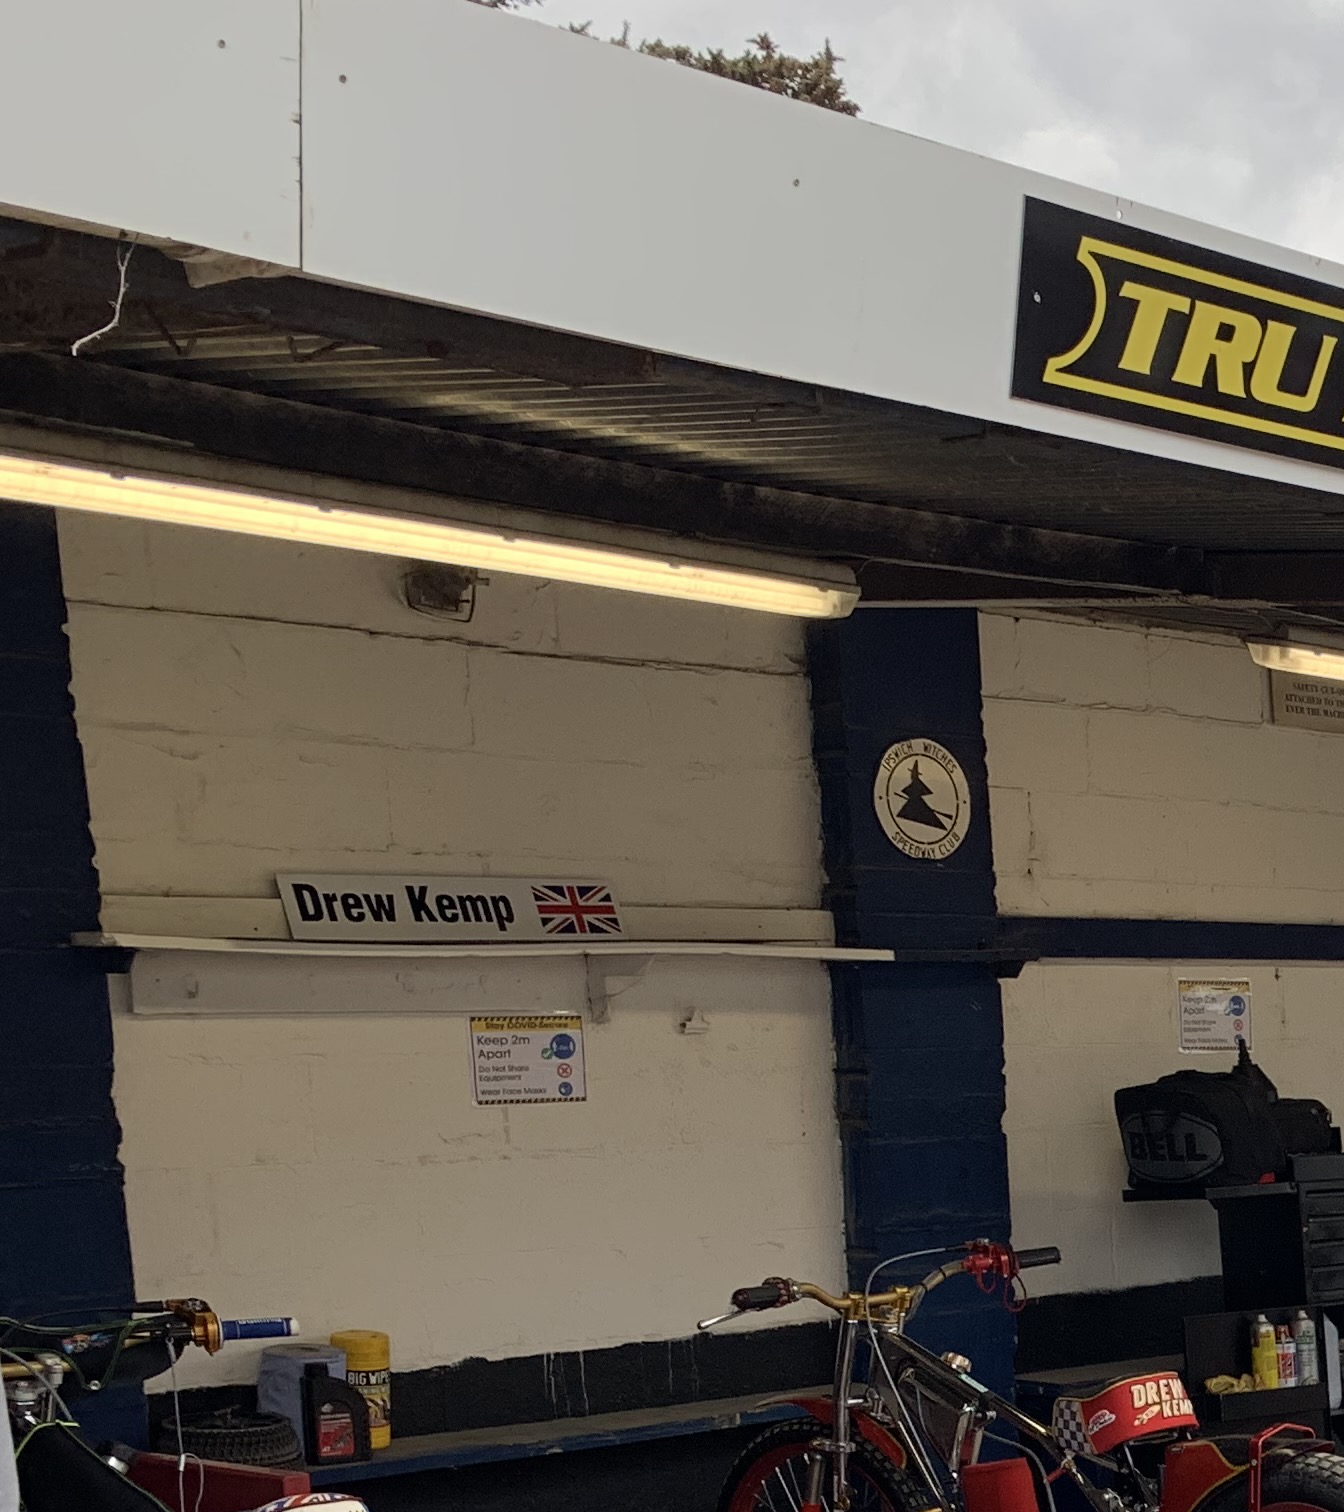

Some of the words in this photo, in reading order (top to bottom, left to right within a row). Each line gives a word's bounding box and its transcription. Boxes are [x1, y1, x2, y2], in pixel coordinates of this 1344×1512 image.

[1114, 281, 1338, 414] TRU
[882, 742, 914, 772] IPSWICH
[921, 742, 957, 774] WITCHES
[892, 831, 936, 859] SPEEDWAY
[938, 831, 960, 856] CLUB
[292, 882, 396, 924] Drew
[405, 884, 515, 932] Kemp
[477, 1035, 508, 1047] Keep
[511, 1034, 530, 1045] 2m
[478, 1048, 511, 1060] Apart
[1130, 1132, 1209, 1162] BELL
[348, 1371, 367, 1385] BIG
